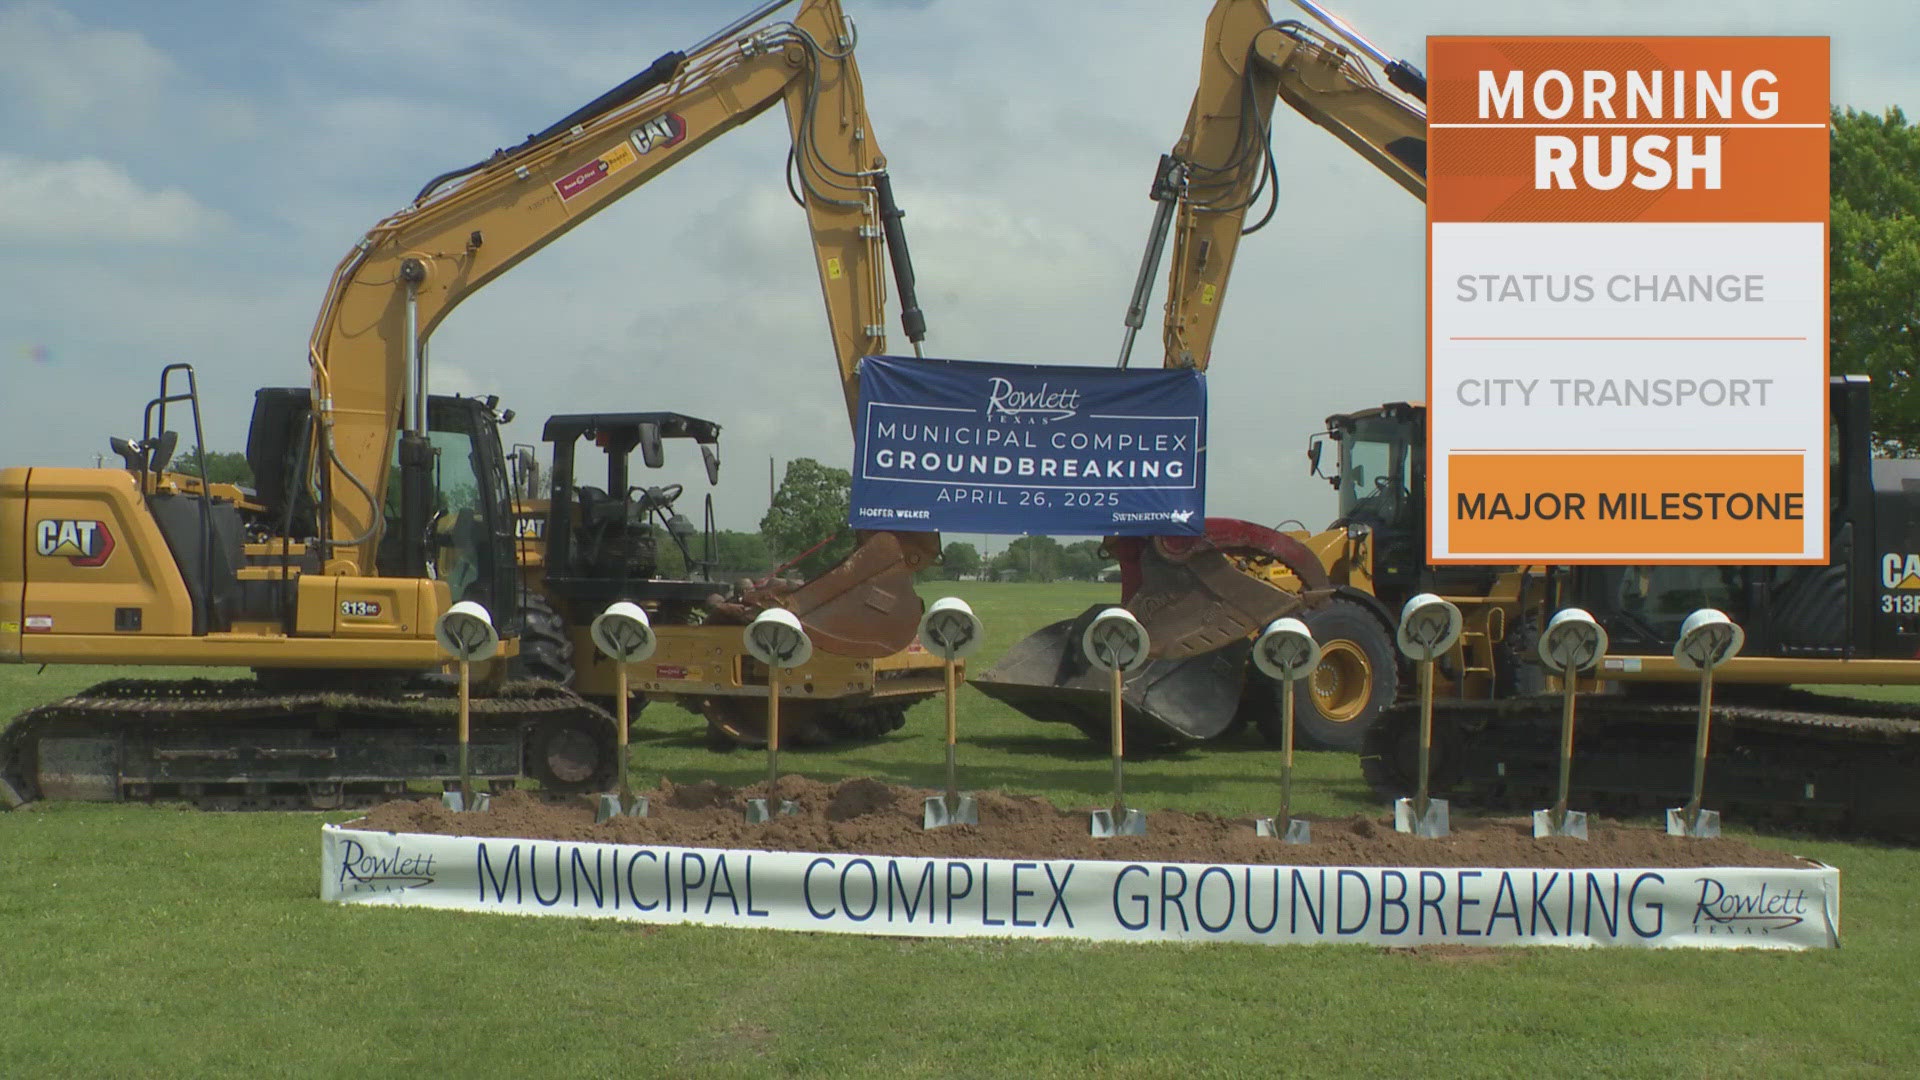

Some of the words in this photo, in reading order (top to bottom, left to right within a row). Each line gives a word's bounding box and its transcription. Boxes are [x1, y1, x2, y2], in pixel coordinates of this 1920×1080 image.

[629, 114, 675, 154] CAT
[987, 377, 1080, 415] Rowlett
[987, 415, 1048, 425] TEXAS
[877, 421, 1037, 448] MUNICIPAL
[1051, 432, 1187, 451] COMPLEX
[876, 449, 1184, 478] GROUNDBREAKING
[936, 487, 1008, 505] APRIL
[1019, 491, 1053, 508] 26,
[1064, 492, 1120, 507] 2025
[859, 507, 894, 518] HOEFER
[896, 508, 930, 519] WELKER
[1112, 511, 1171, 522] SWINERTON
[37, 519, 97, 556] CAT
[515, 518, 545, 538] CAT
[340, 839, 437, 883] Rowlett
[477, 842, 769, 917] MUNICIPAL
[803, 857, 1075, 929] COMPLEX
[1113, 864, 1665, 939] GROUNDBREAKING
[1693, 877, 1809, 924] Rowlett
[1692, 924, 1770, 935] TEXAS
